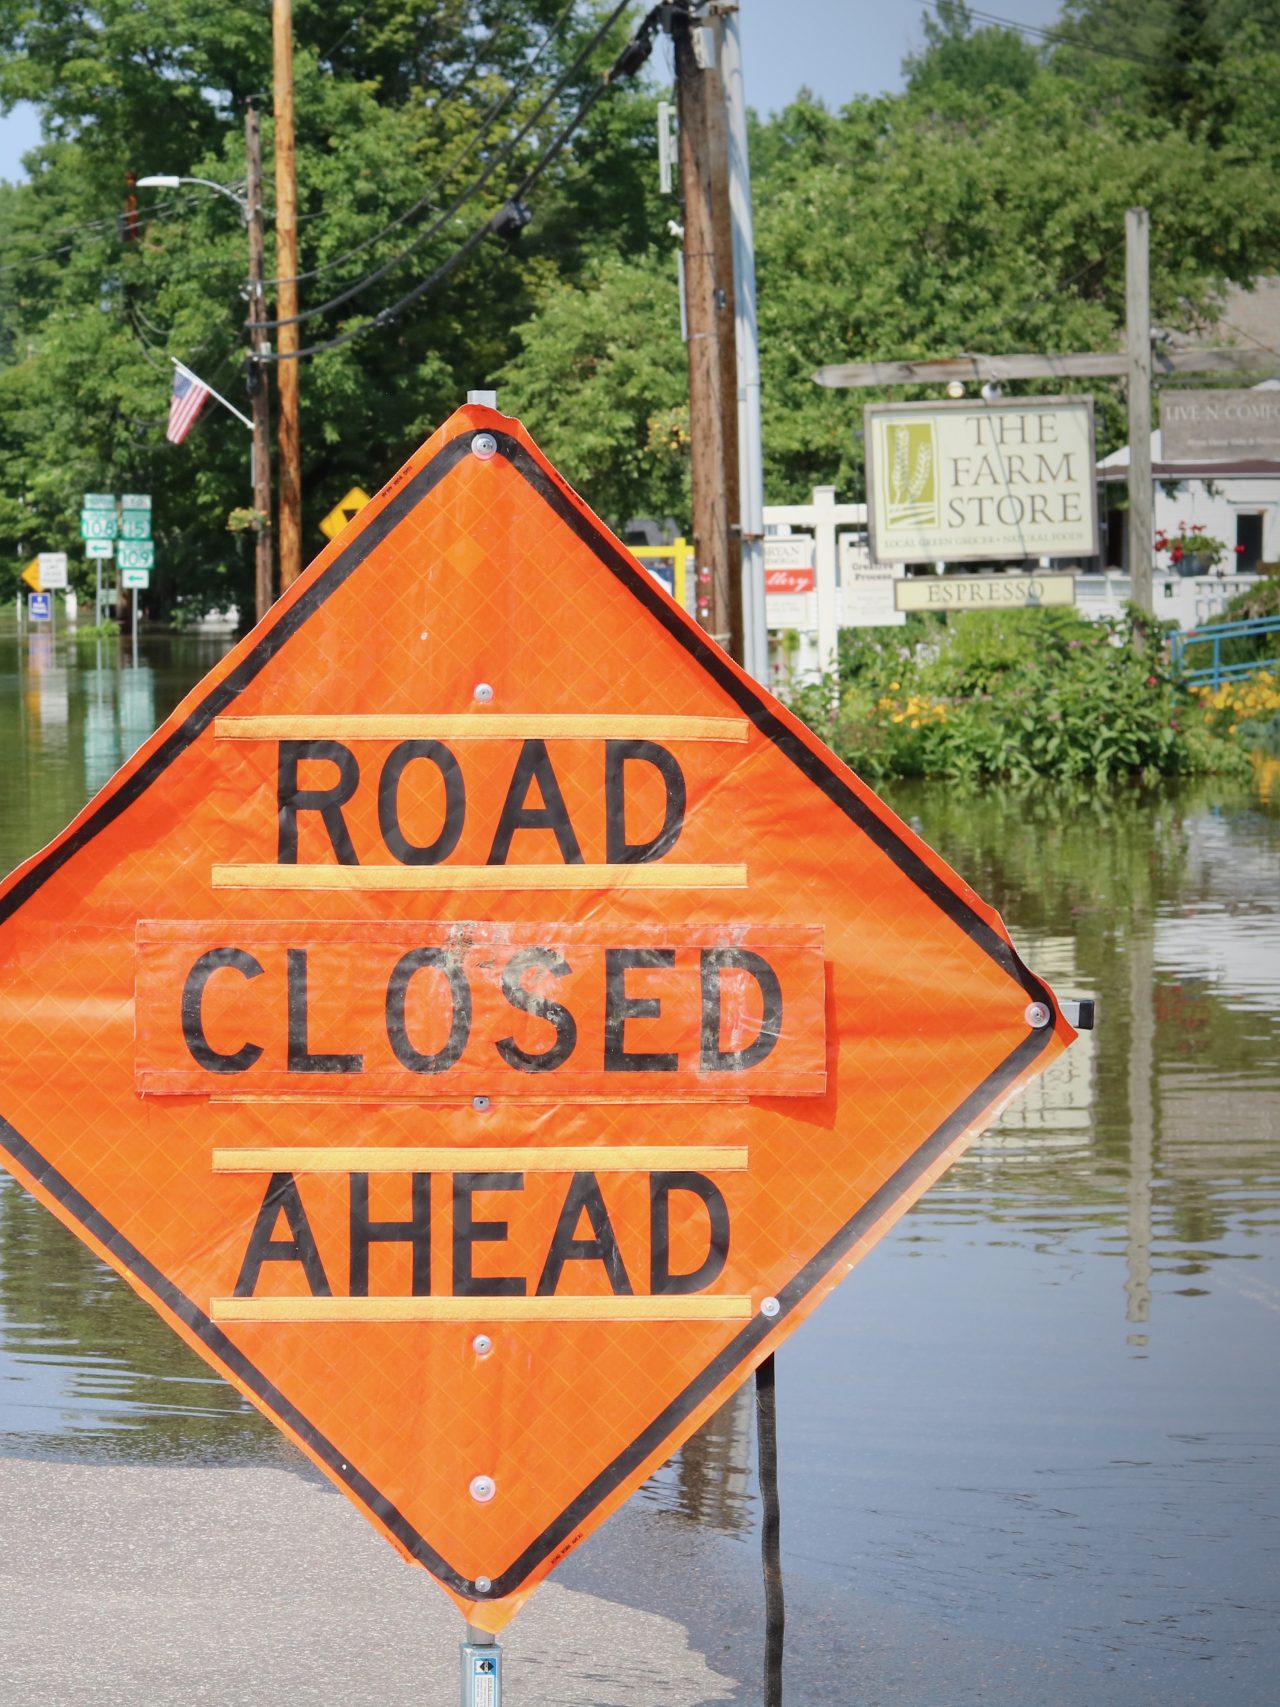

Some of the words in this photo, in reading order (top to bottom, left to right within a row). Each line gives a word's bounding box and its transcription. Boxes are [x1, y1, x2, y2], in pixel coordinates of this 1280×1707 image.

[966, 413, 1059, 446] THE
[950, 452, 1078, 488] FARM
[947, 492, 1083, 528] STORE
[86, 521, 115, 537] 108
[128, 521, 145, 537] 15
[884, 538, 916, 549] LOCAL
[920, 537, 953, 547] GREEN
[955, 536, 994, 546] GROCER
[1003, 533, 1050, 543] NATURAL
[1052, 532, 1084, 542] FOODS
[122, 551, 149, 567] 109
[927, 581, 1045, 603] ESPRESSO
[277, 738, 686, 863] ROAD
[180, 947, 783, 1073] CLOSED
[234, 1171, 730, 1297] AHEAD
